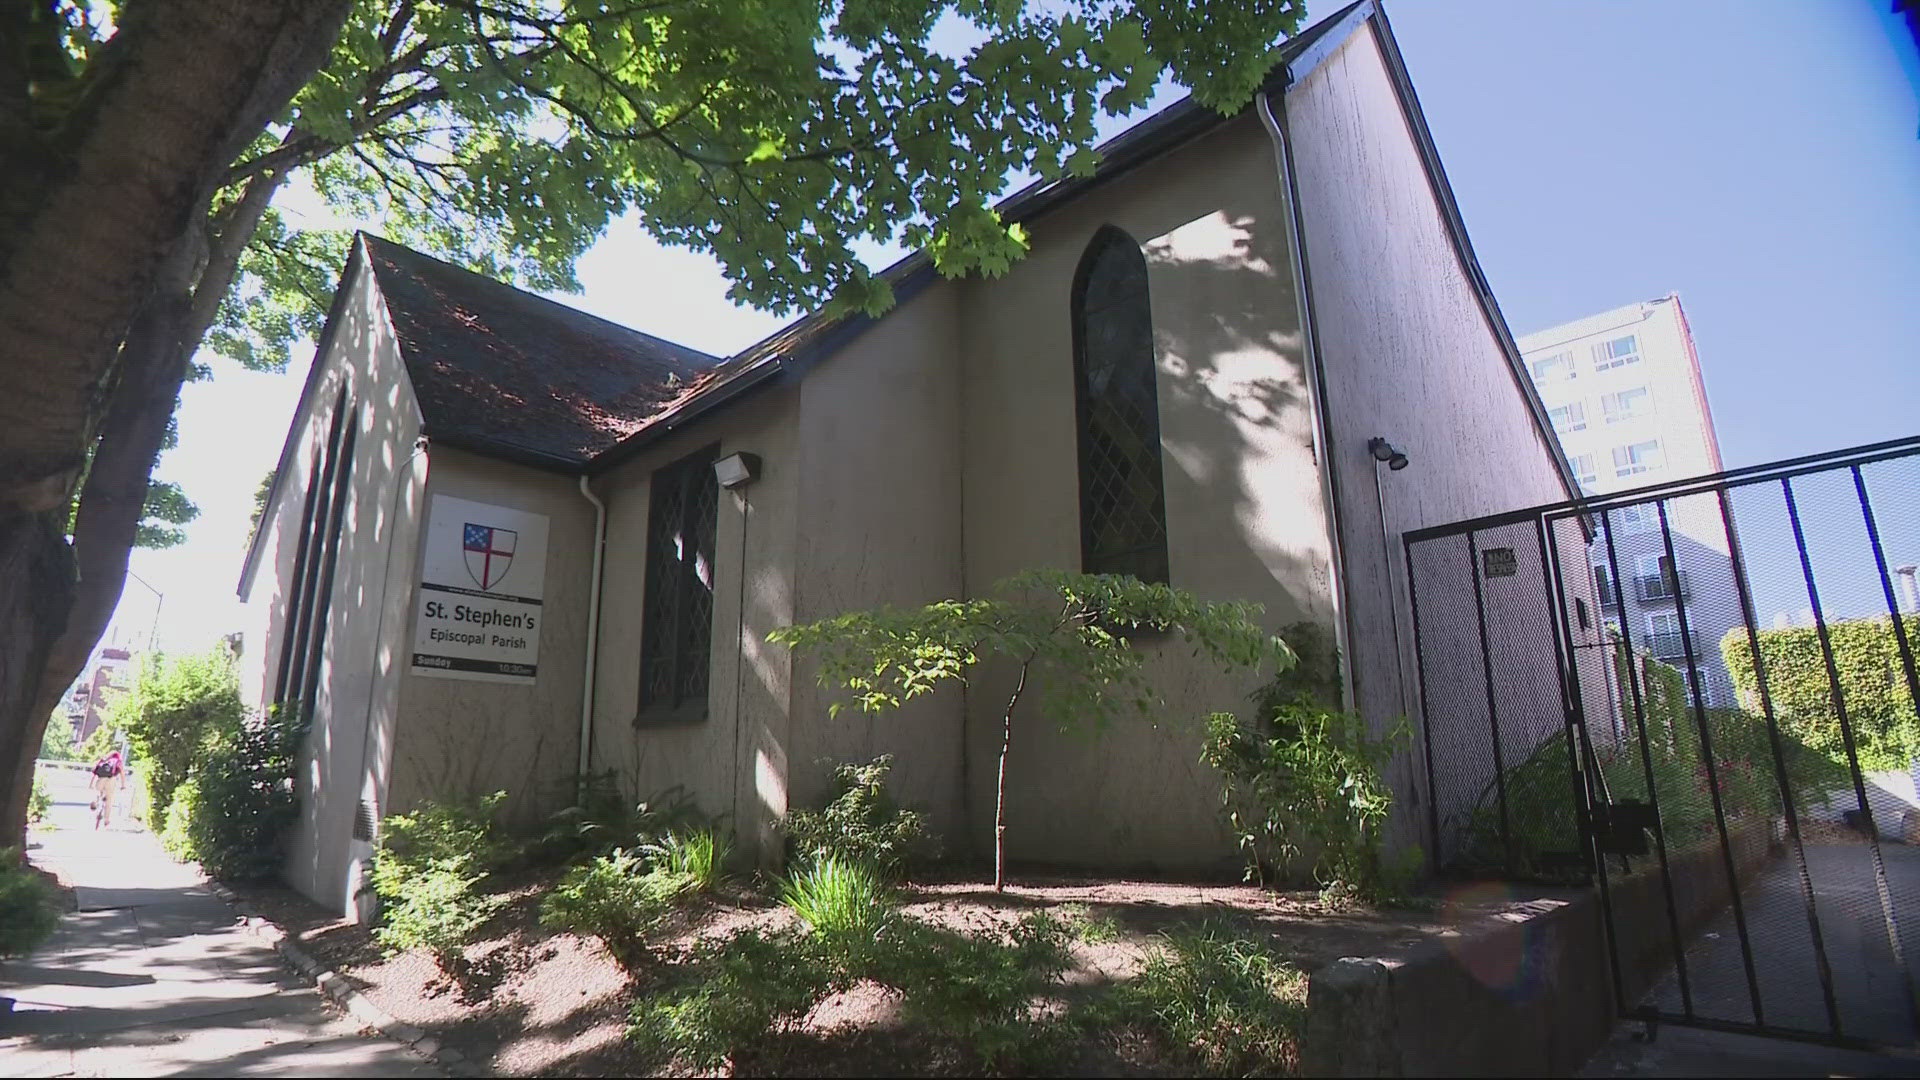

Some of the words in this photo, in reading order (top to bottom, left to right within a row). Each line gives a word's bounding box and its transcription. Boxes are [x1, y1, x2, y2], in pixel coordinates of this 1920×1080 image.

[425, 601, 449, 620] St.
[454, 604, 535, 630] Stephen's
[430, 627, 486, 646] Episcopal
[492, 634, 526, 649] Parish
[417, 655, 451, 669] Sunday
